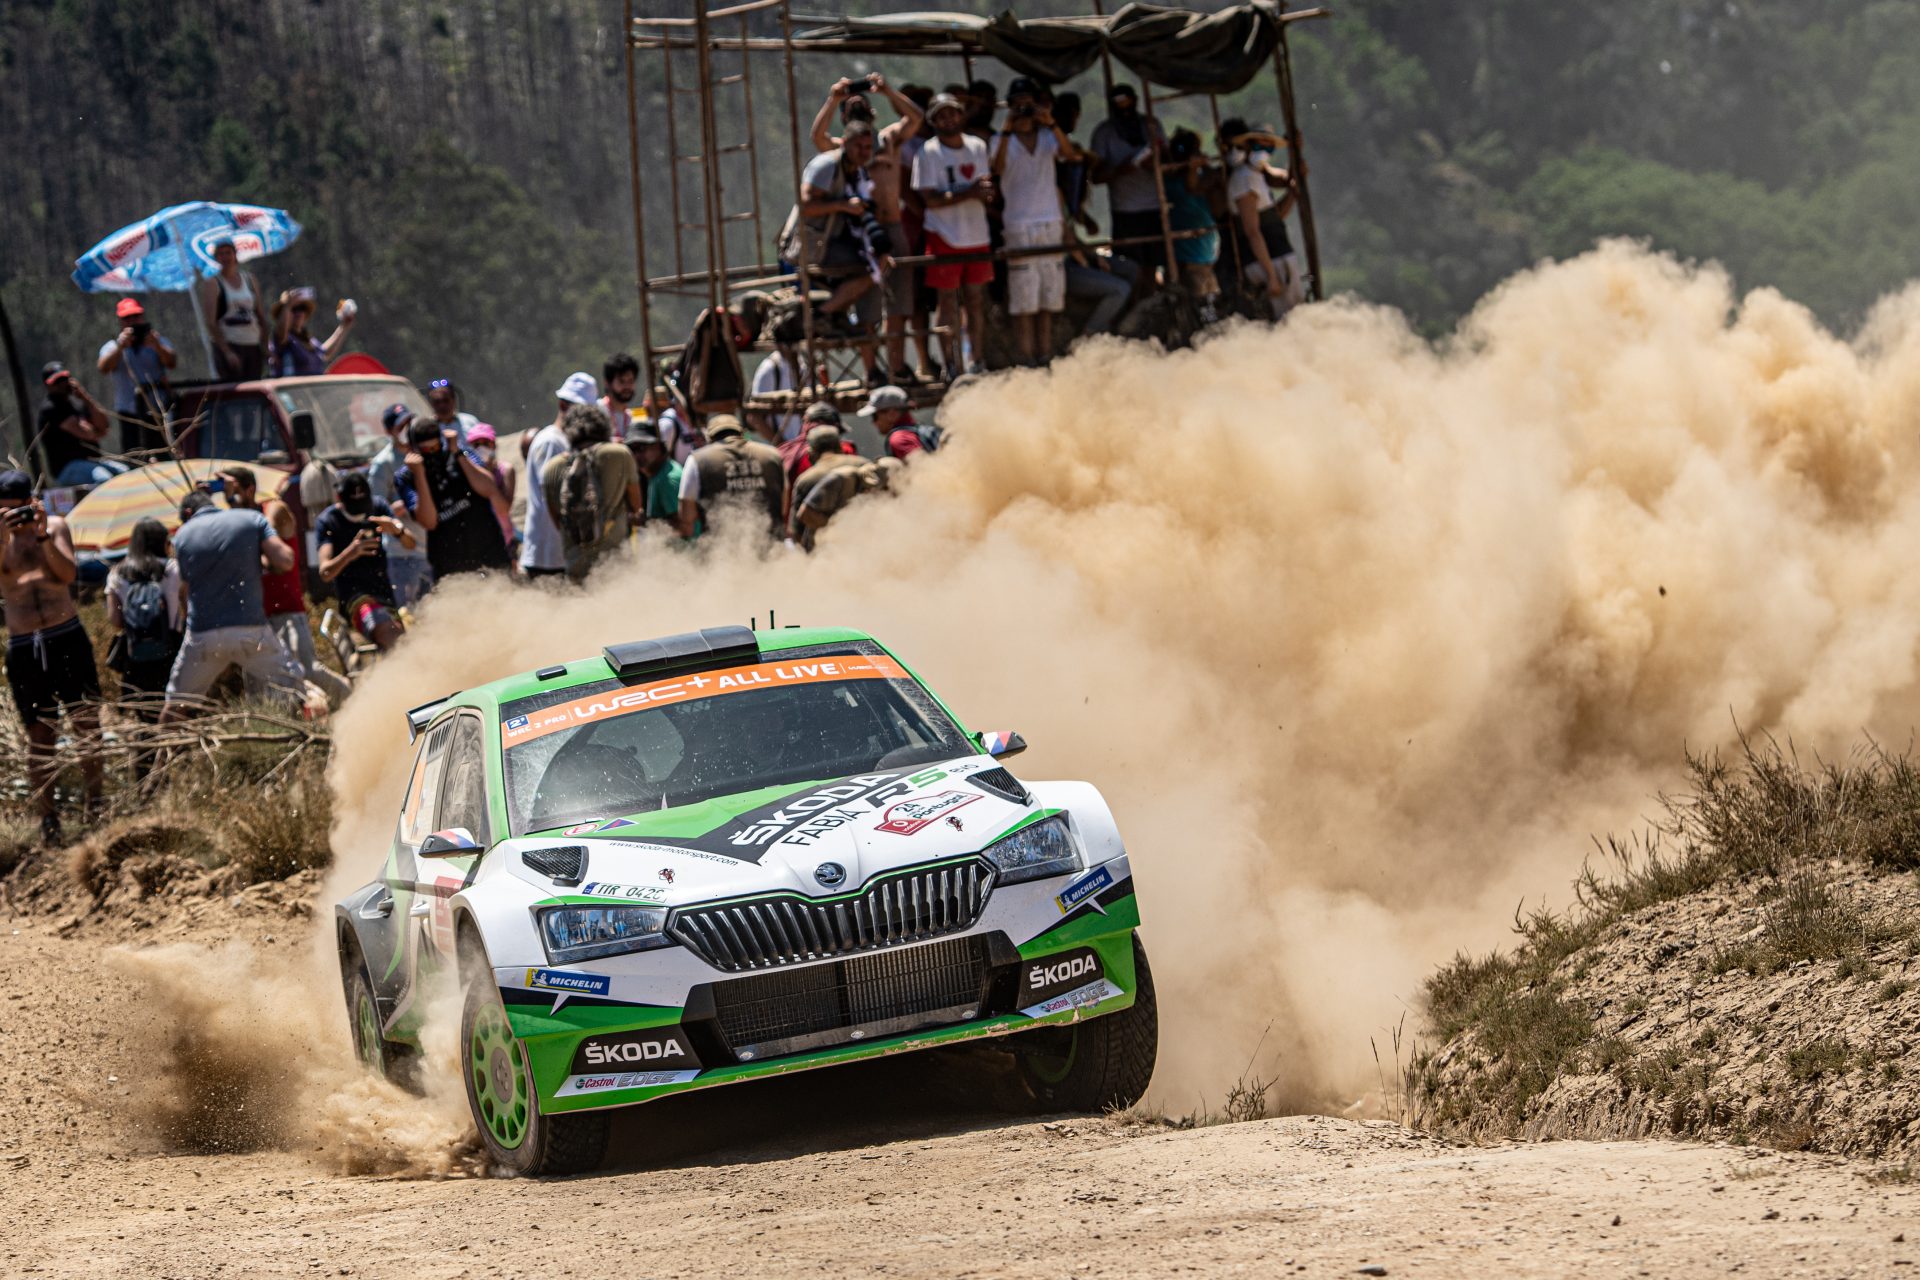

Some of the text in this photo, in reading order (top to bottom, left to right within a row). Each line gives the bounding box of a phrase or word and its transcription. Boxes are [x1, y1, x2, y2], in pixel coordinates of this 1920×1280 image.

[727, 477, 766, 490] MEDIA
[719, 671, 771, 688] ALL
[776, 663, 839, 679] LIVE
[508, 726, 531, 737] WRC
[544, 714, 566, 725] PRO
[728, 774, 899, 845] ŠKODA
[781, 808, 871, 845] FABIA
[1071, 874, 1105, 901] MICHELIN
[550, 977, 603, 990] MICHELIN
[1029, 954, 1096, 989] ŠKODA
[1068, 981, 1109, 1005] EDGE
[585, 1039, 685, 1064] ŠKODA
[585, 1072, 680, 1088] Castrol EDGE
